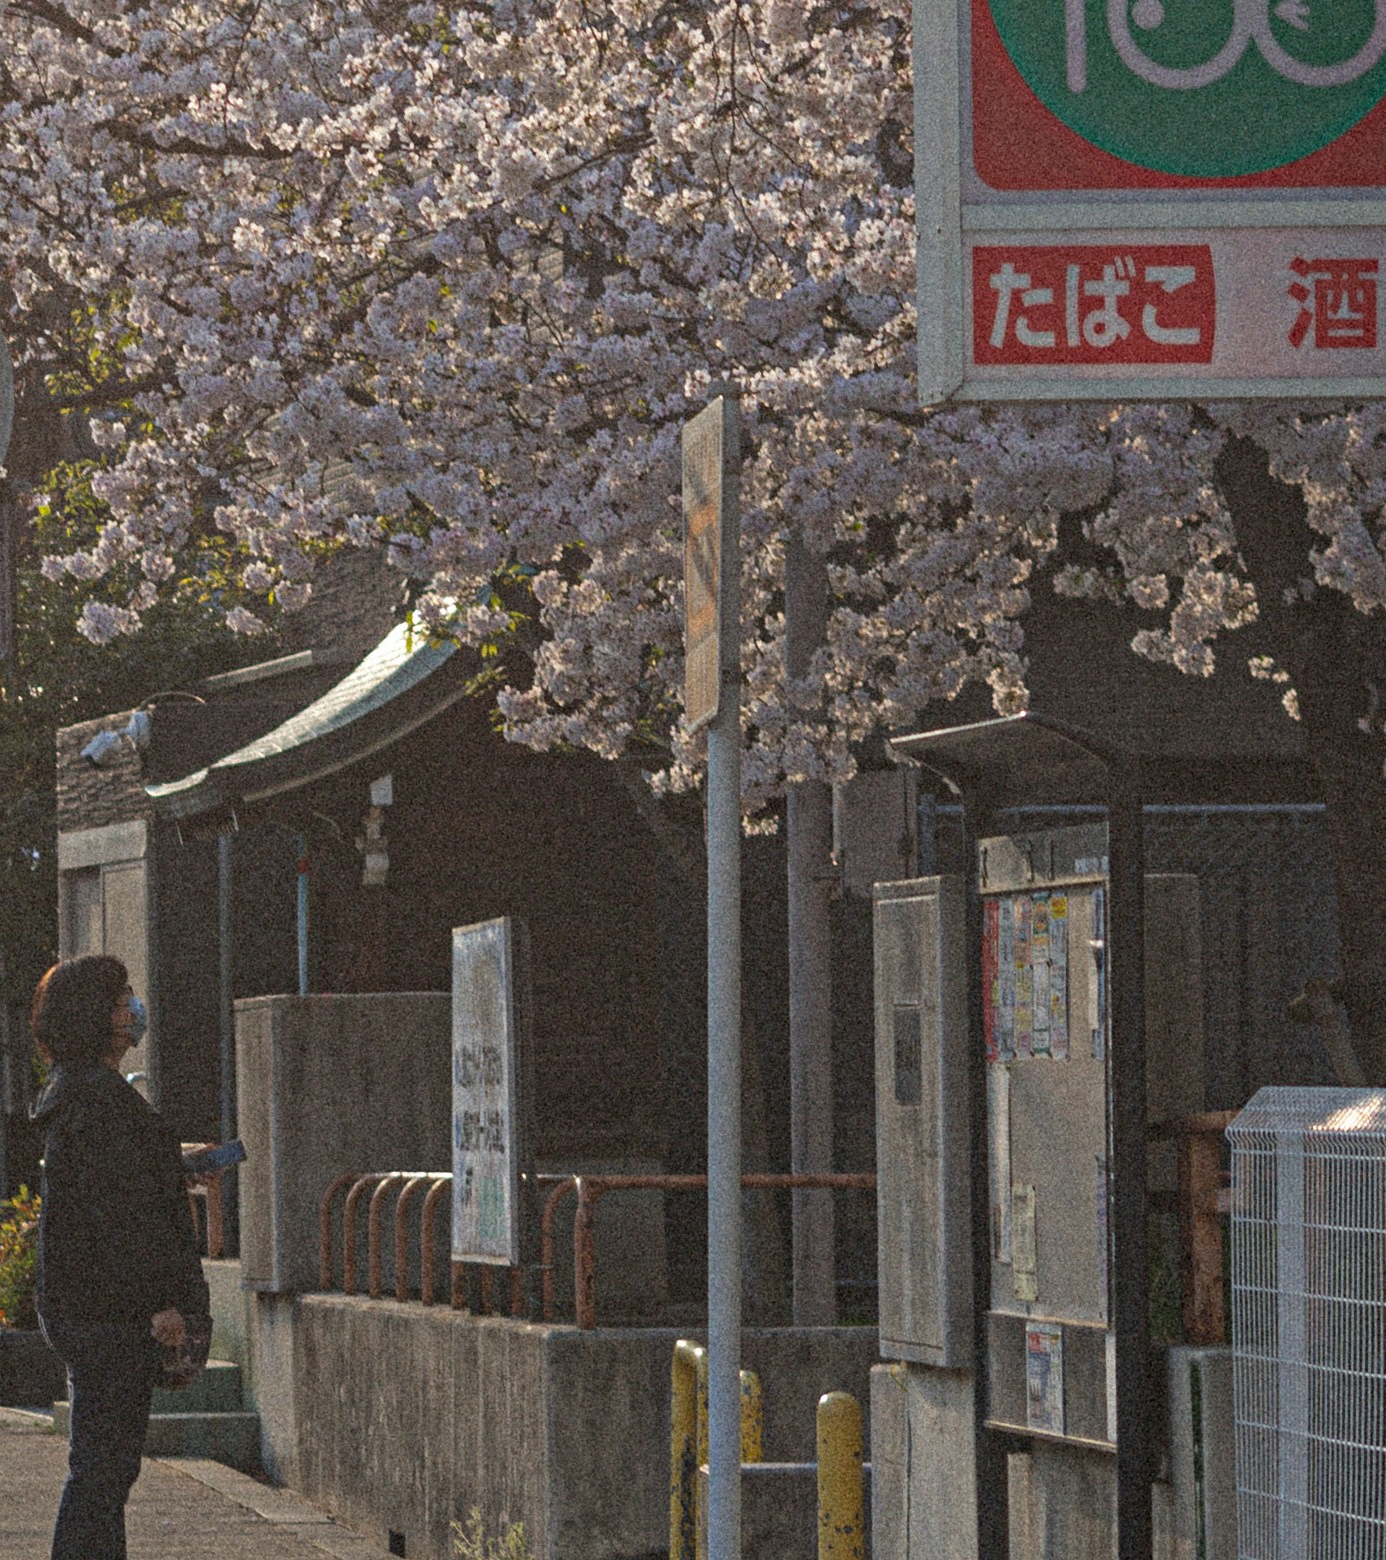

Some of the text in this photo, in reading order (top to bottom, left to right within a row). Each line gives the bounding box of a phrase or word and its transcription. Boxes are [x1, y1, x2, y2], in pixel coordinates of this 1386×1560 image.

[989, 254, 1202, 350] たばこ
[1286, 254, 1380, 349] 酒
